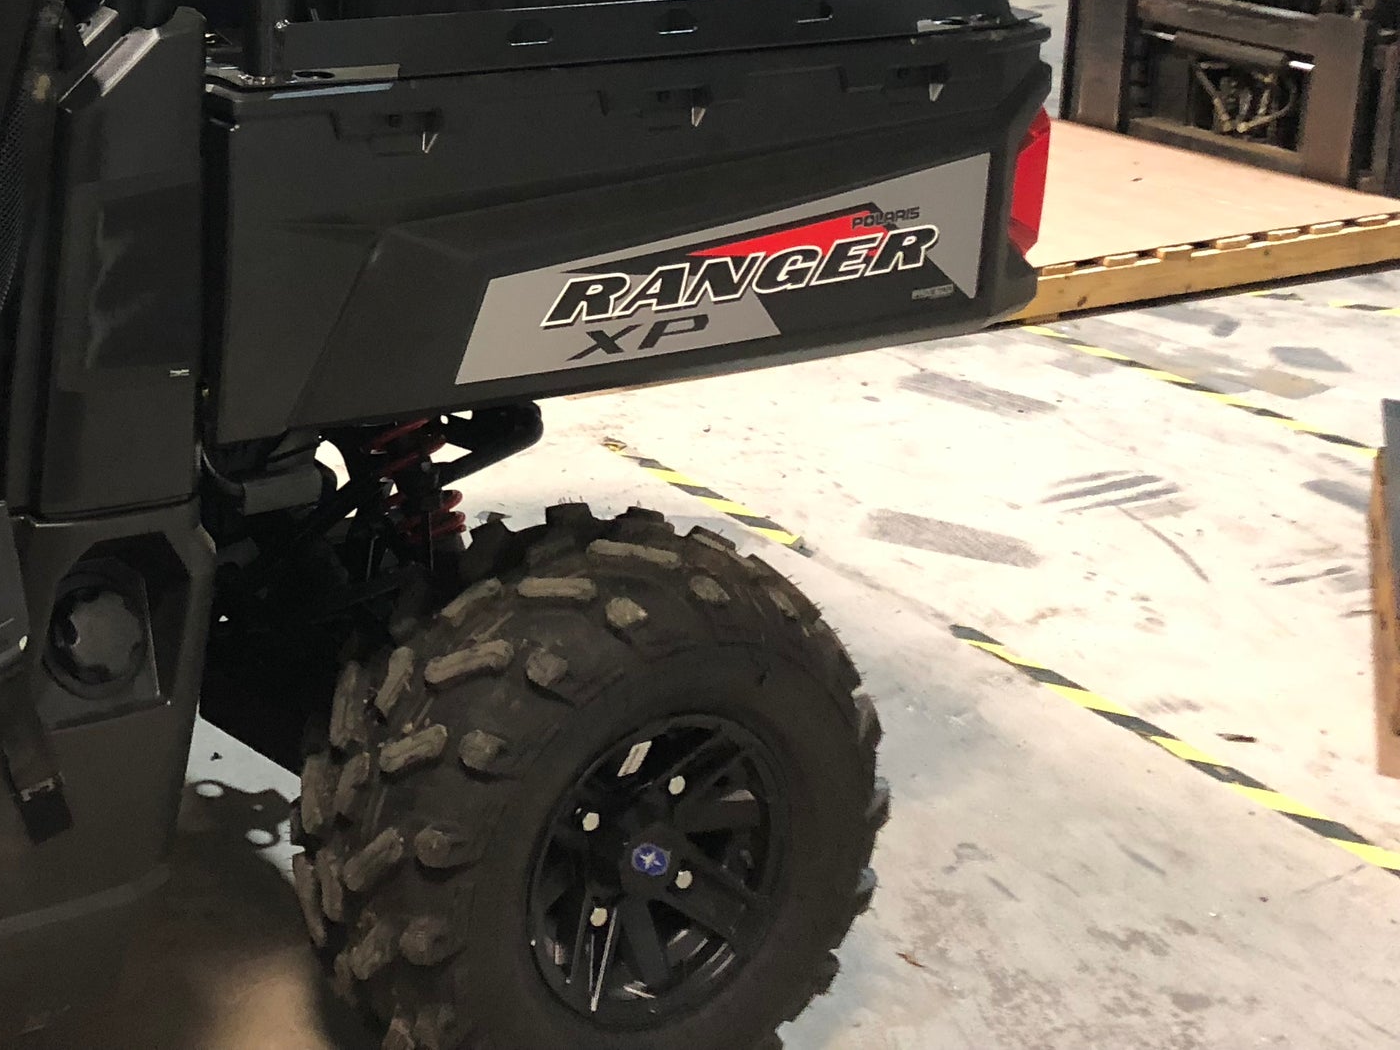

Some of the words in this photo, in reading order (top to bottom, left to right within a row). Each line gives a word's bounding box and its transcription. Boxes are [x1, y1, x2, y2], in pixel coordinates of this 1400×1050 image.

[852, 206, 921, 230] POLARIS
[540, 224, 940, 329] RANGER
[566, 313, 710, 362] XP
